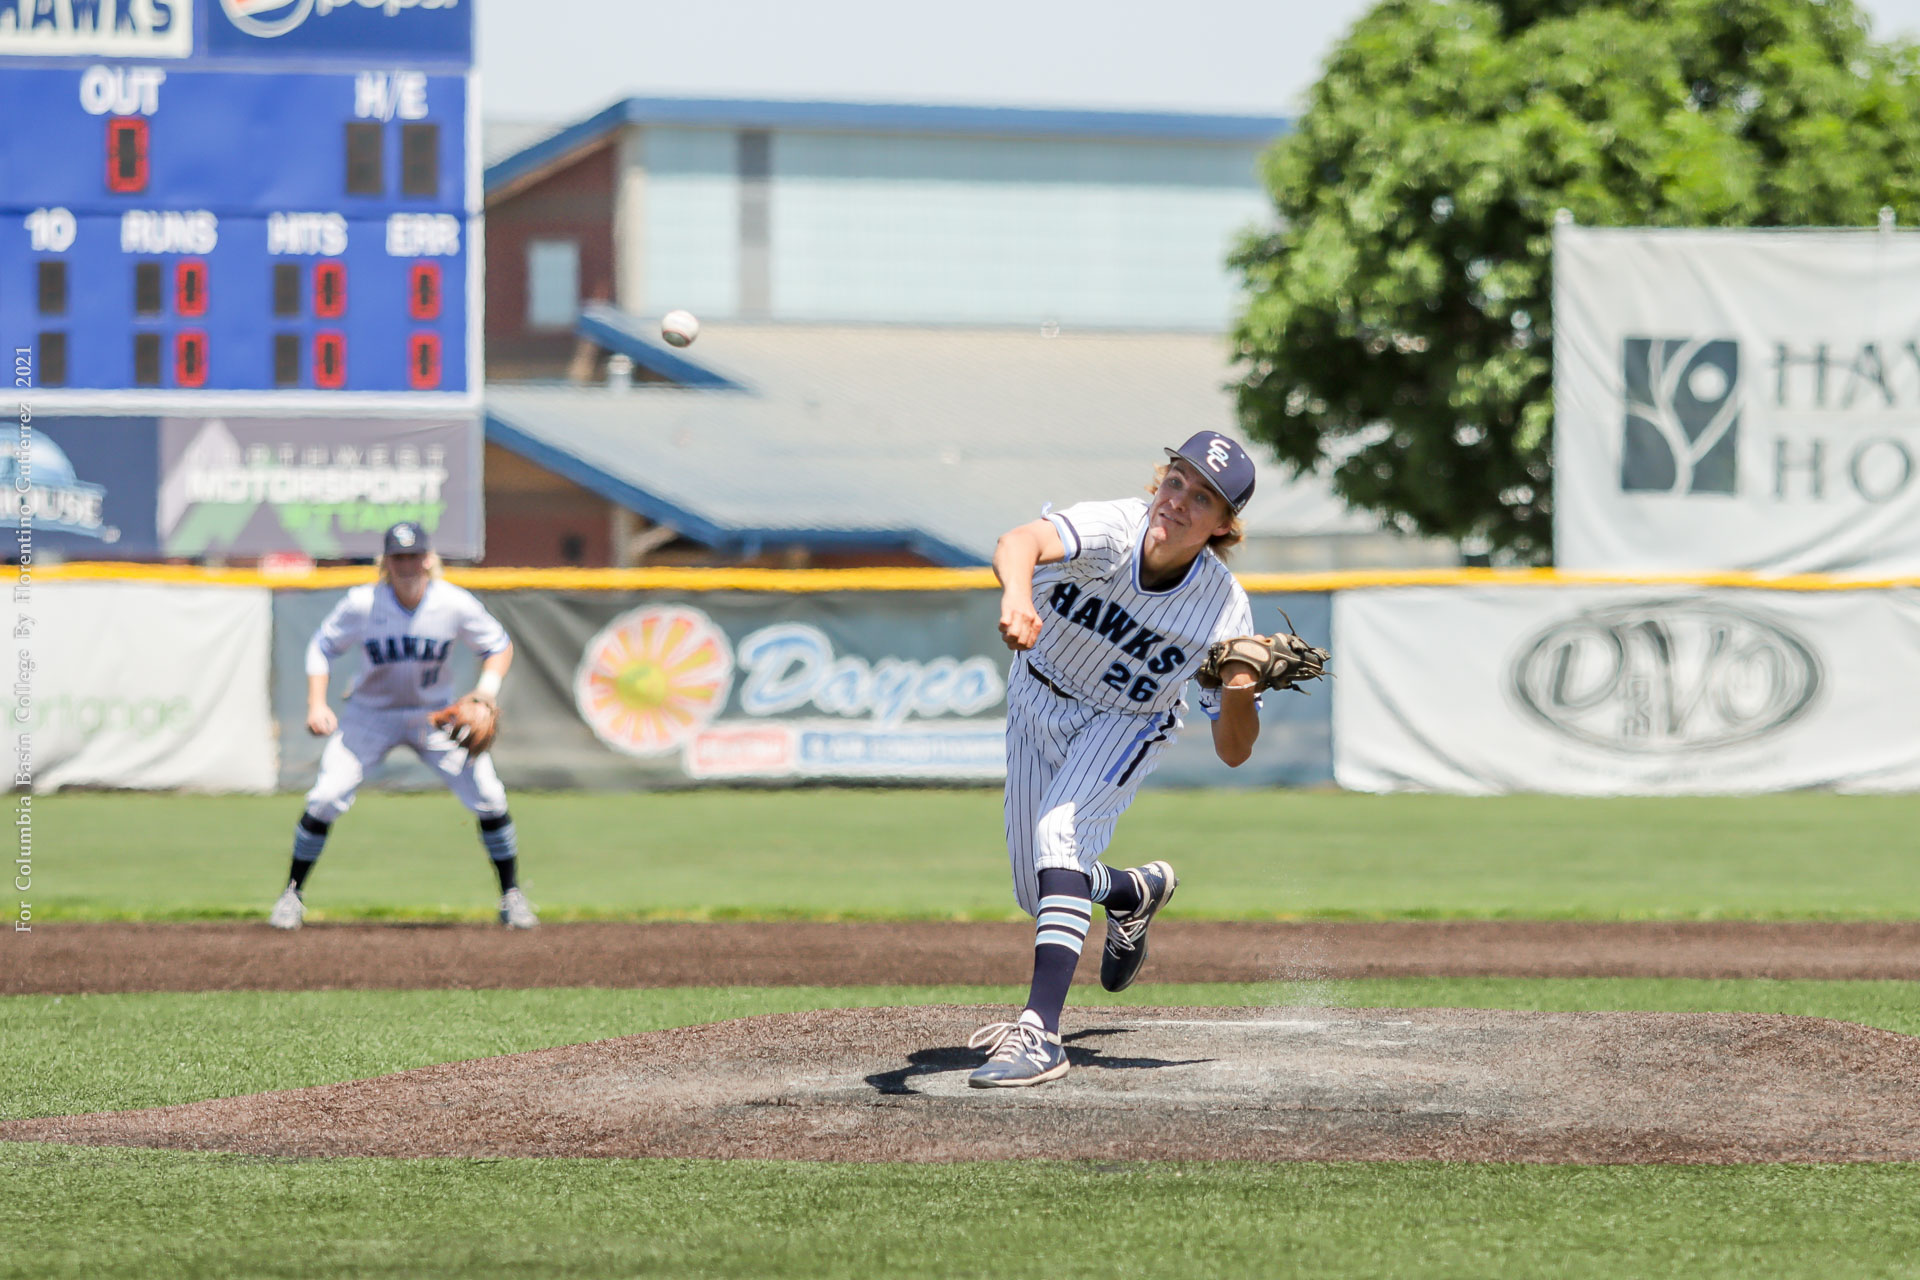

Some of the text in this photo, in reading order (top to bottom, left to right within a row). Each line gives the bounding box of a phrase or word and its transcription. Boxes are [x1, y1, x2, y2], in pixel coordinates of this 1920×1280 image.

[0, 0, 172, 32] AWKS
[80, 65, 165, 116] OUT
[354, 71, 428, 121] H/E
[107, 116, 149, 193] 0
[24, 208, 461, 257] 10 RUNS HITS ERR
[175, 260, 442, 319] 0 0 0
[174, 332, 442, 389] 0 0 0
[1774, 341, 1920, 407] HA
[1049, 581, 1187, 675] HAWKS
[737, 622, 1002, 725] Dayco
[1101, 660, 1162, 703] 26
